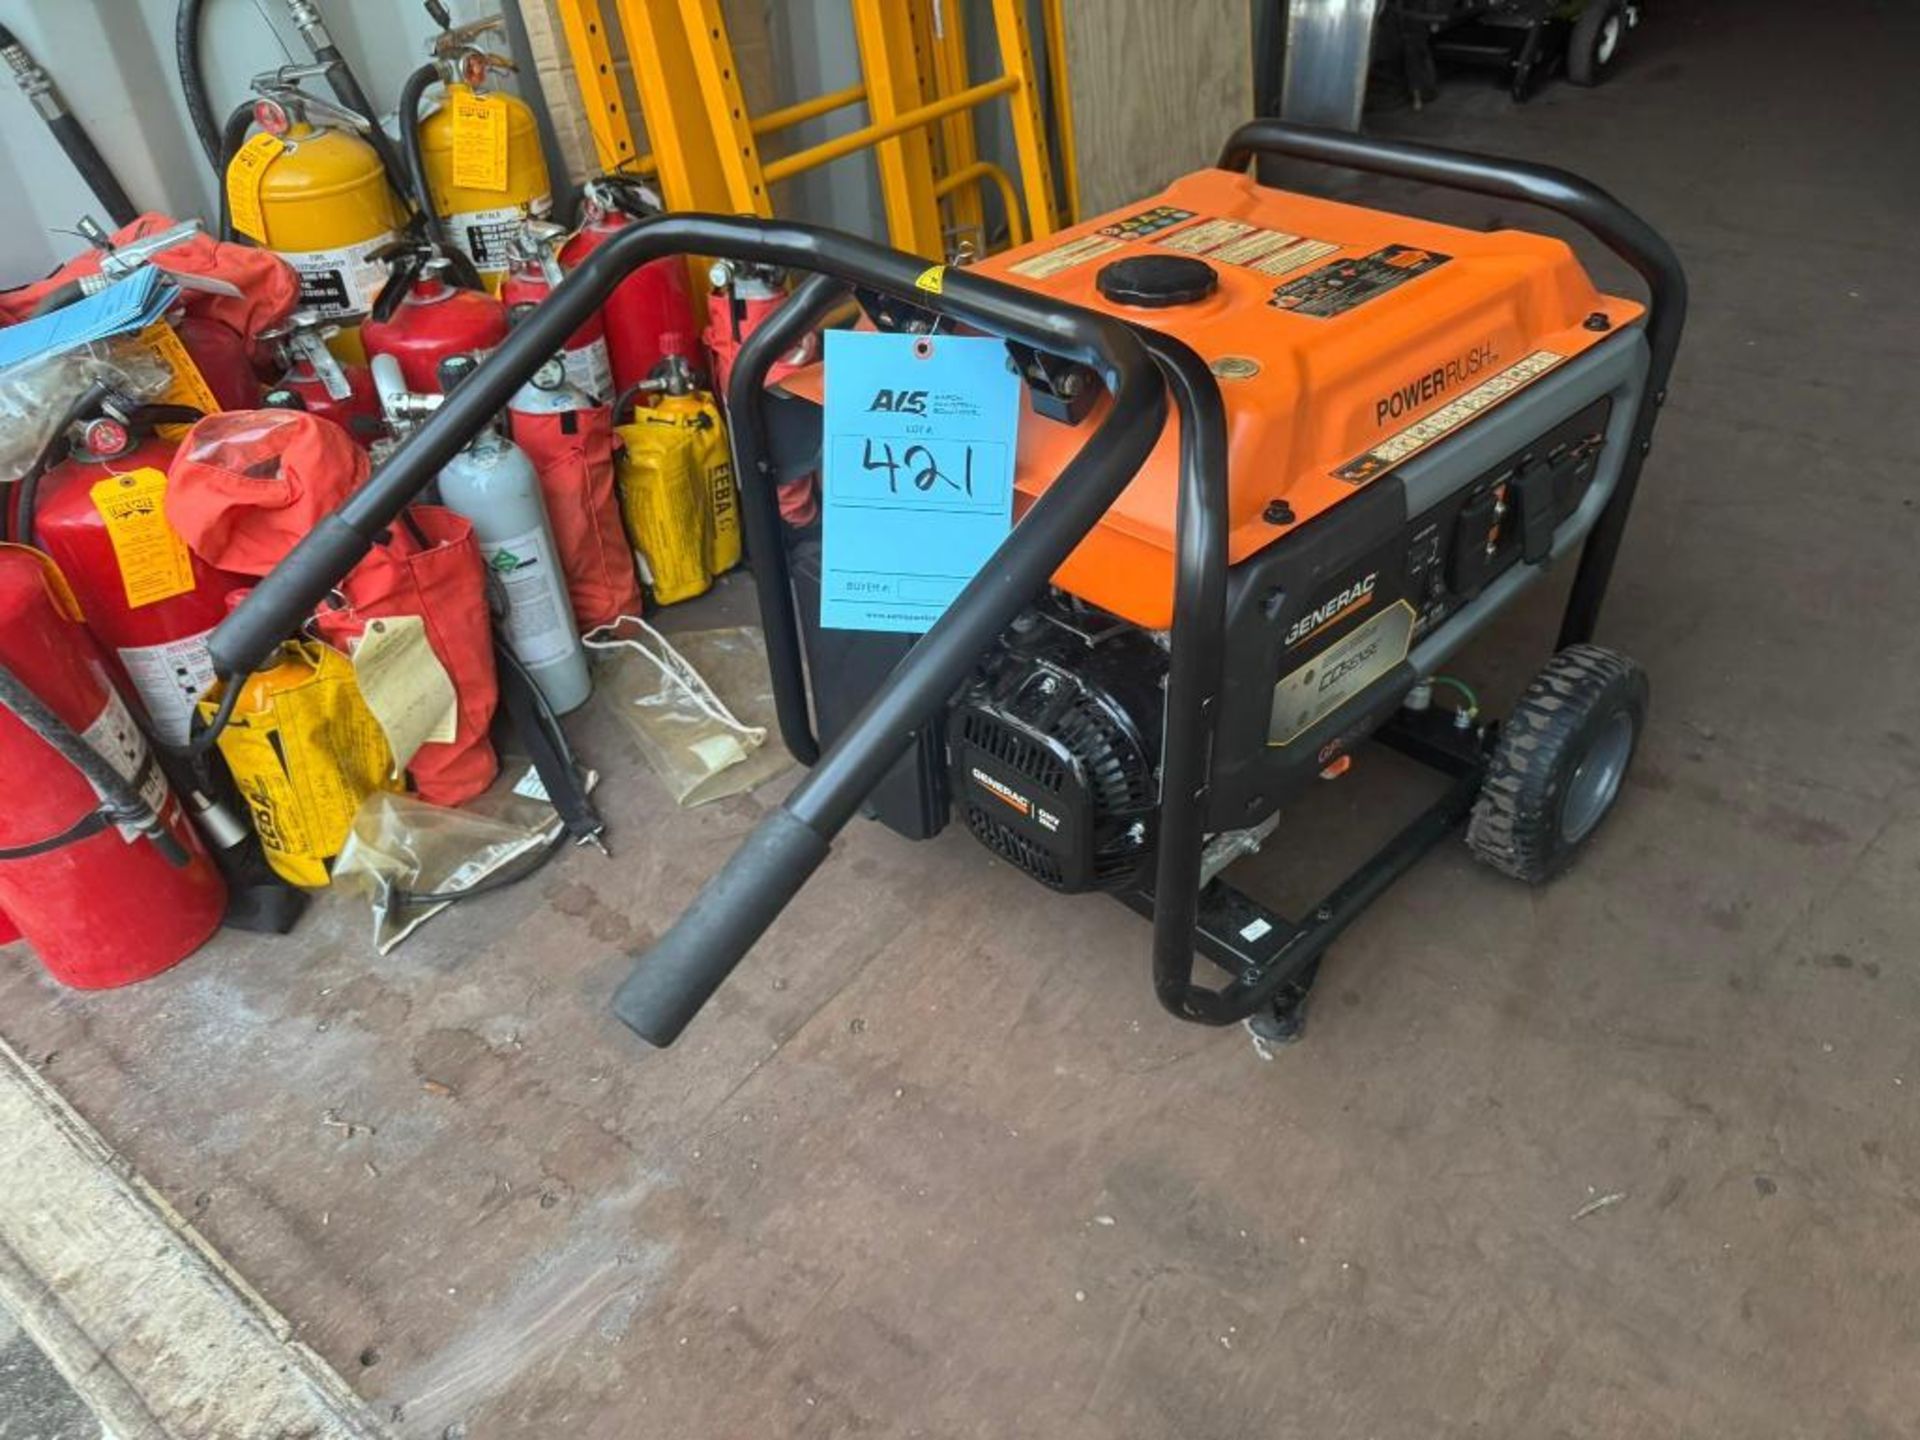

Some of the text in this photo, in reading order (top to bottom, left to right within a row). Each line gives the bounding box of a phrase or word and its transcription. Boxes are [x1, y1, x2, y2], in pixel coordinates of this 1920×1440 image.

[865, 388, 929, 418] AIS
[1376, 341, 1493, 427] POWERRUSH
[863, 438, 973, 499] 421
[1284, 572, 1379, 646] GENERAC
[972, 767, 1031, 807] GENERAC
